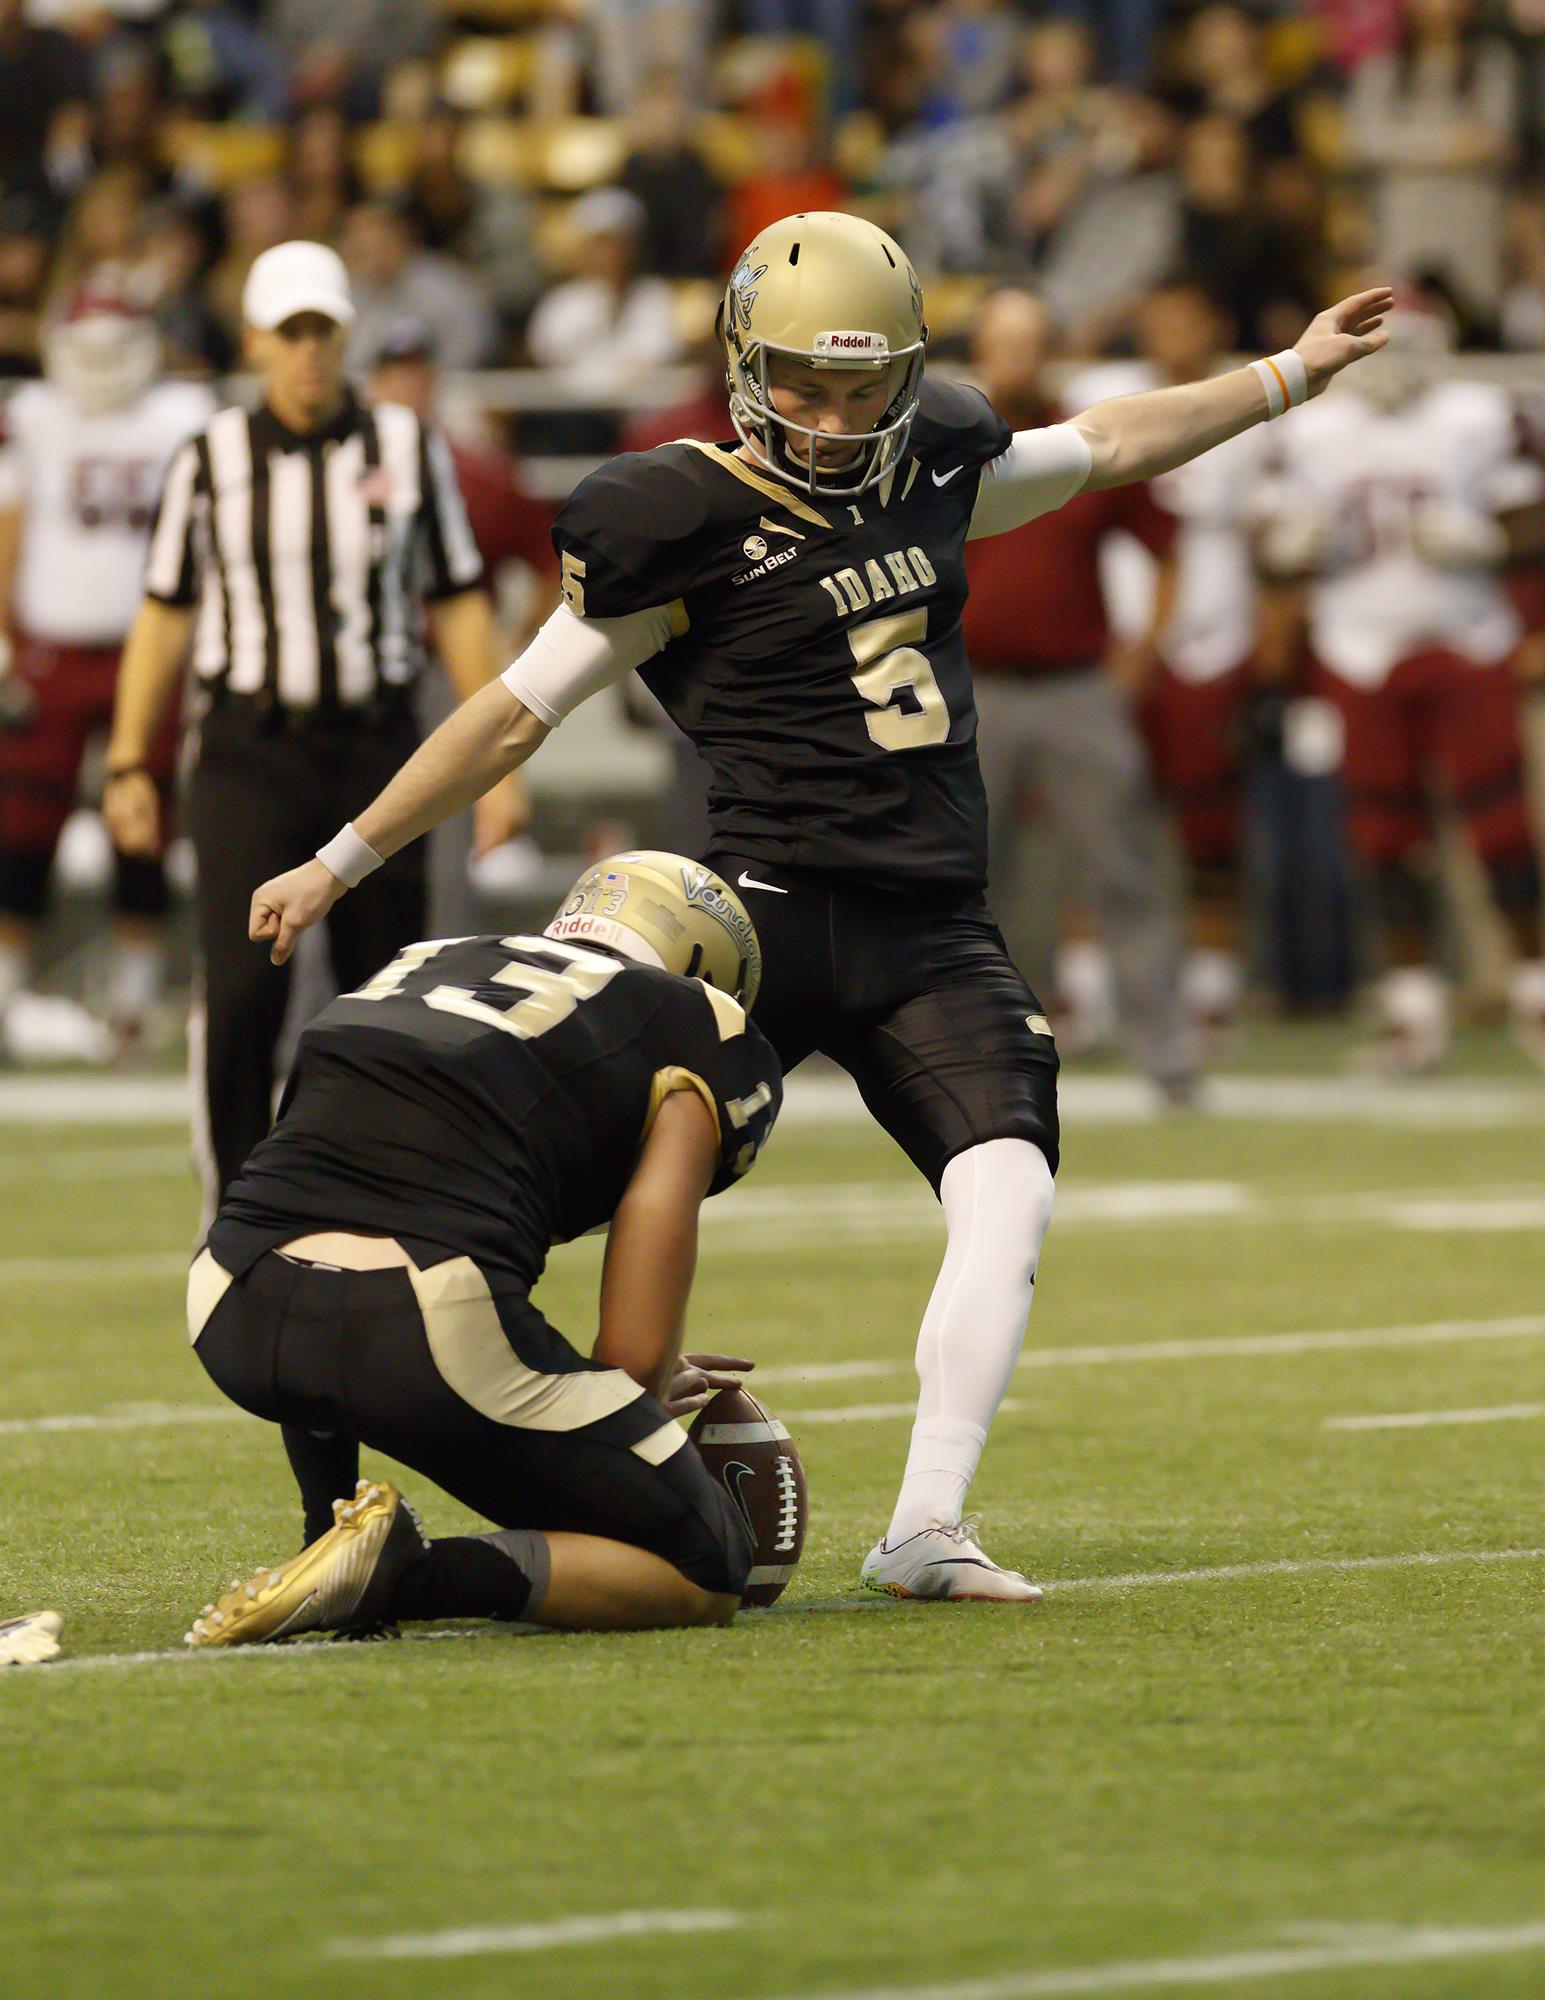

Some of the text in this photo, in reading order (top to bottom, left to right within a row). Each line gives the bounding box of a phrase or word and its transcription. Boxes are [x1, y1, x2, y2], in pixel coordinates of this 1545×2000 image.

[831, 335, 872, 349] Riddell
[819, 545, 938, 617] IDAHO
[847, 605, 951, 752] 5
[552, 917, 626, 944] Riddell
[338, 934, 627, 1040] 13
